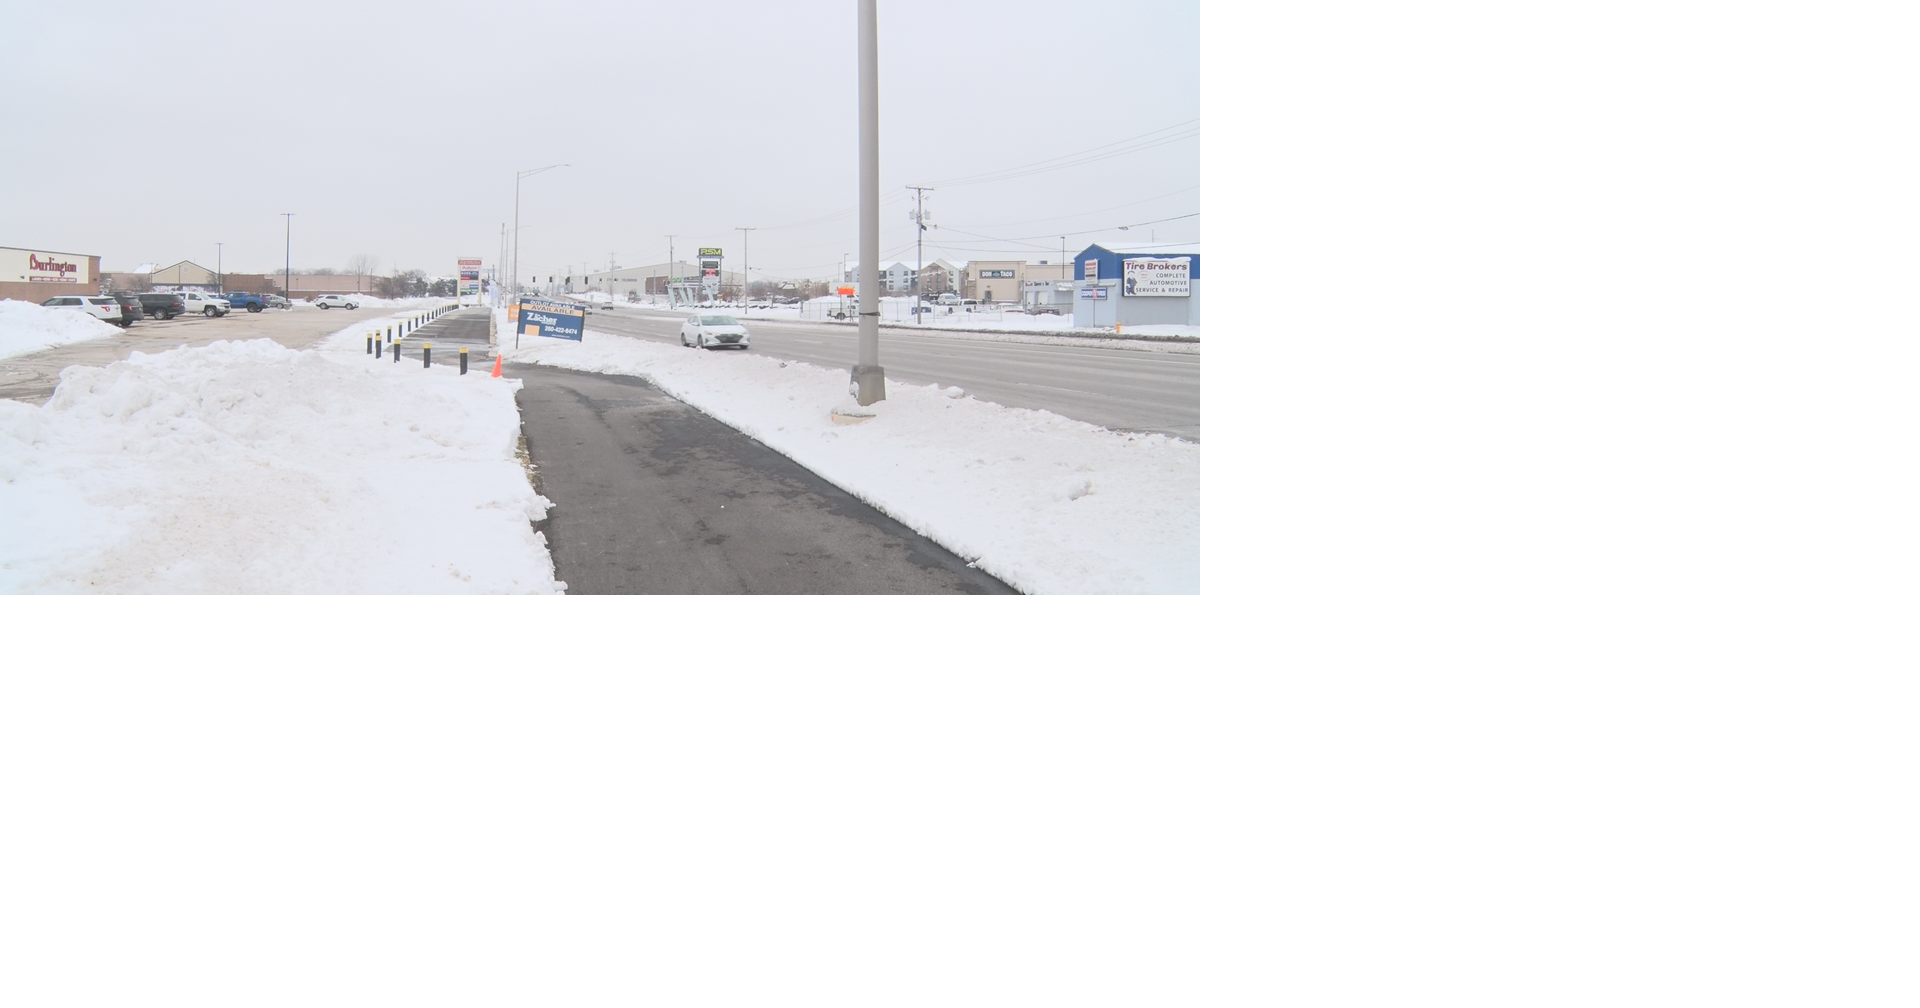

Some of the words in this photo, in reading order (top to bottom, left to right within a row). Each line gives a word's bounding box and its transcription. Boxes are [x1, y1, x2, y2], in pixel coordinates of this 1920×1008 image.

[29, 253, 77, 277] Burlington
[1126, 262, 1145, 271] Tire
[1147, 262, 1187, 271] Brokers
[531, 305, 575, 315] AVAILABLE
